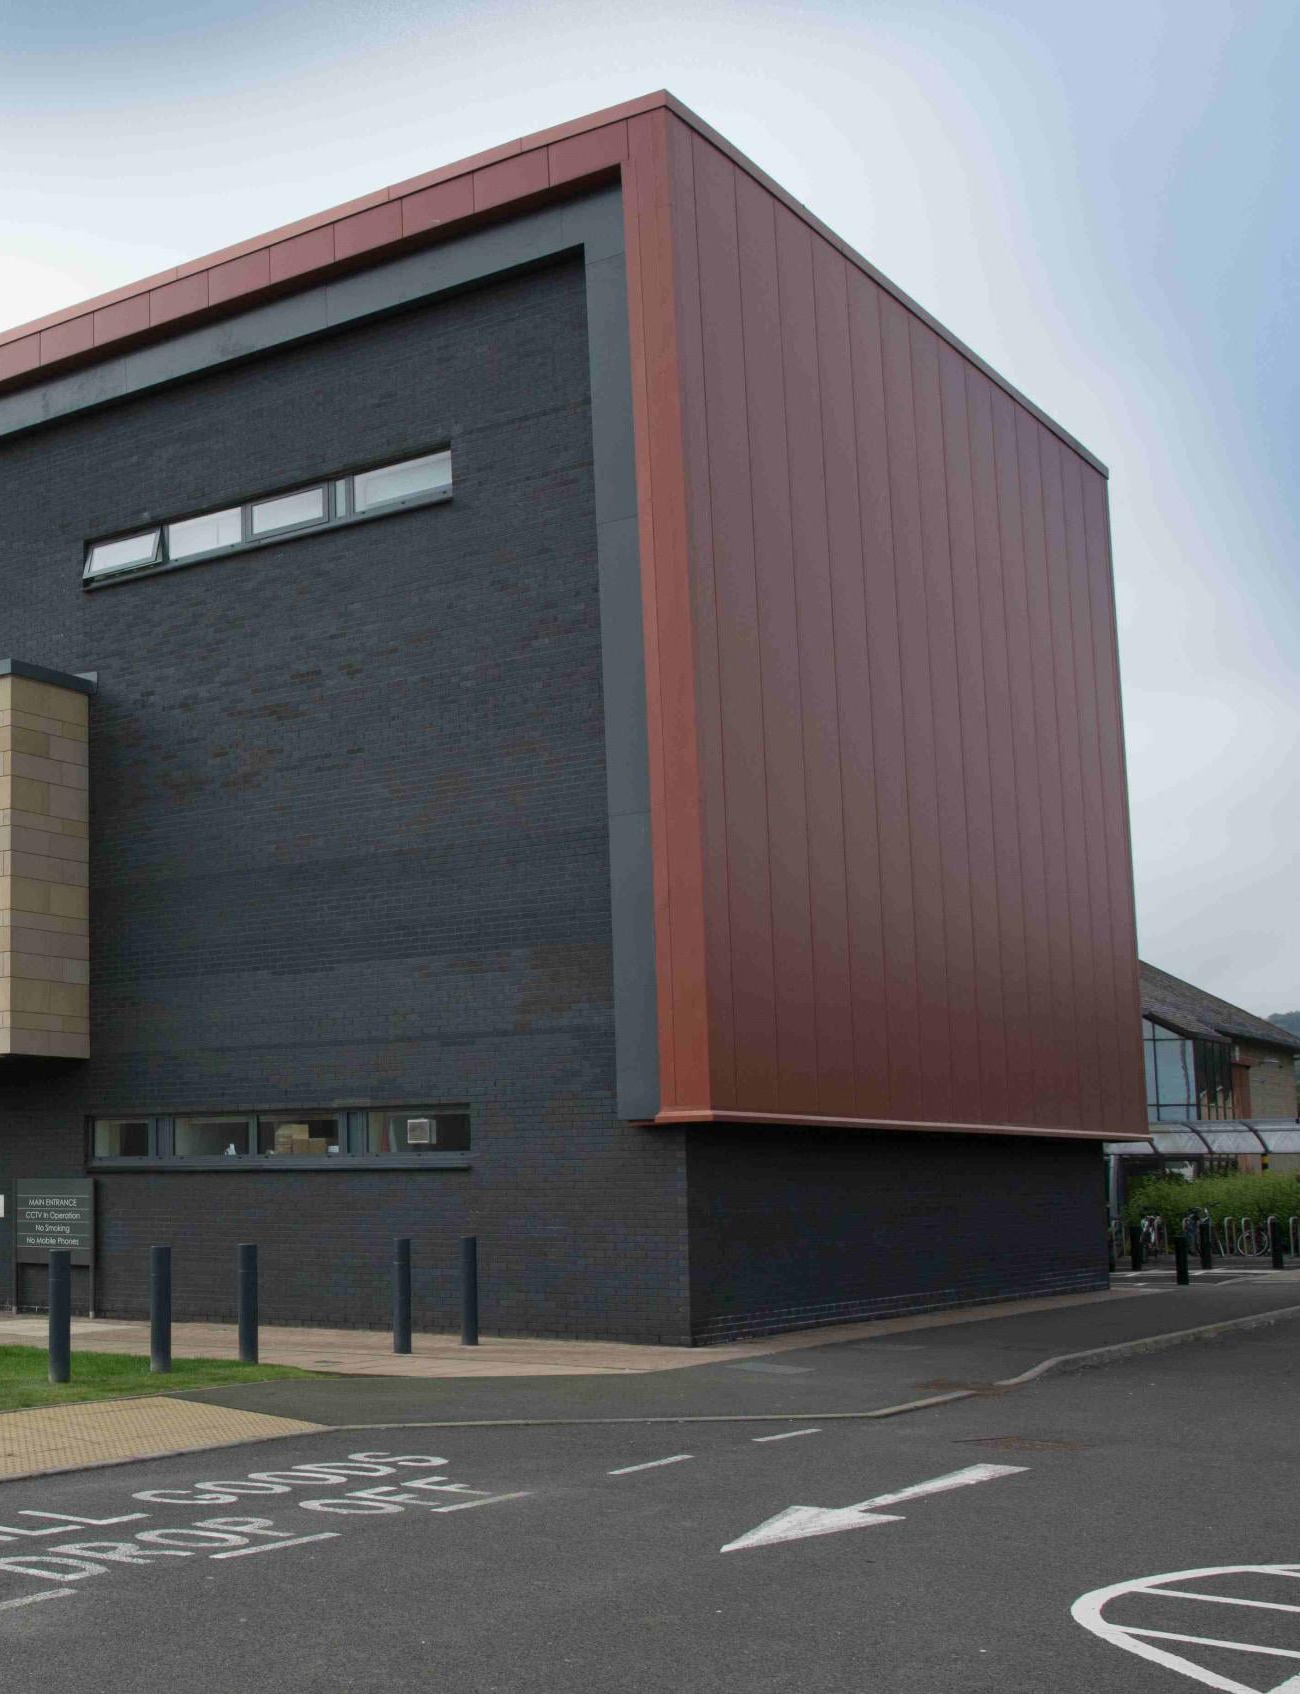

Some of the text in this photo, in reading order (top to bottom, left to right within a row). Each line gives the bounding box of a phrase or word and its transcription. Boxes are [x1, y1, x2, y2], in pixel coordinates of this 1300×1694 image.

[28, 1198, 77, 1207] MAIN ENTRANCE
[25, 1211, 42, 1219] CCTV
[49, 1211, 81, 1220] Operation
[45, 1224, 70, 1234] Smoking
[26, 1236, 79, 1246] No Mobile Phones
[132, 1452, 450, 1504] GOODS
[299, 1476, 492, 1514] OFF
